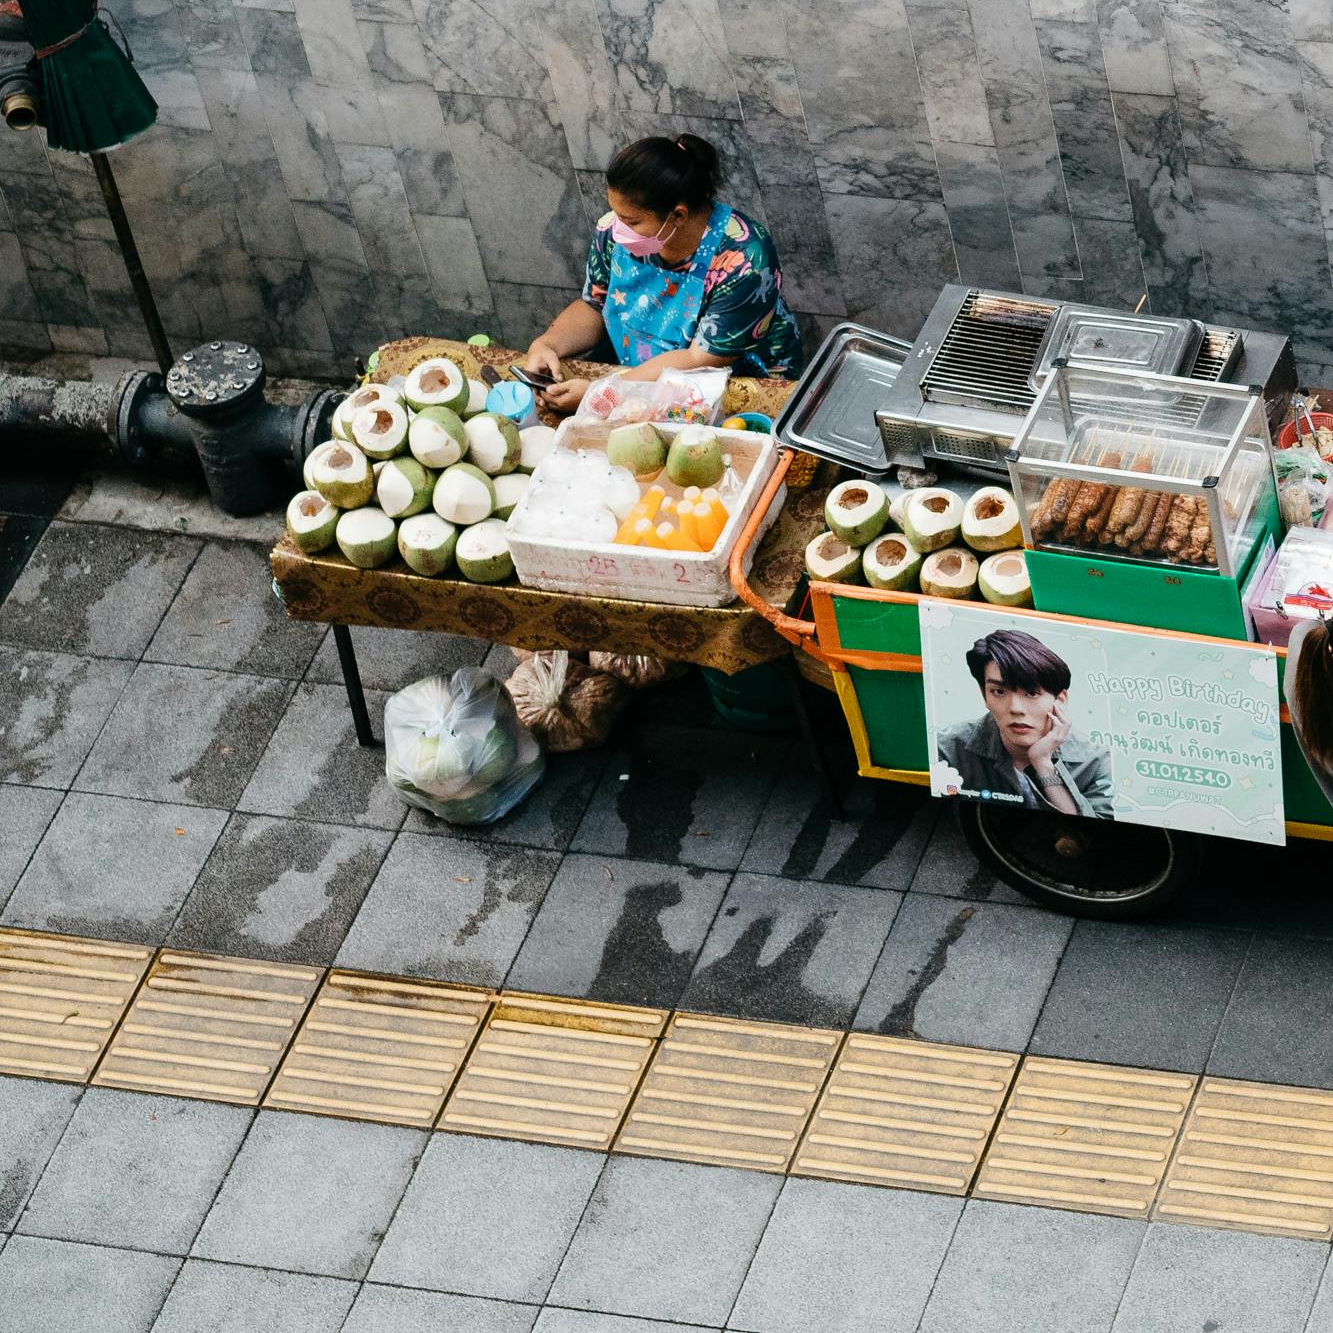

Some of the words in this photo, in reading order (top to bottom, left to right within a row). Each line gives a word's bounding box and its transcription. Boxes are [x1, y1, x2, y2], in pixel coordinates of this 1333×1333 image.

[1088, 672, 1162, 702] Happy
[1167, 675, 1270, 724] Birthday
[1137, 710, 1222, 735] คอปเตอร์
[1090, 729, 1174, 755] ภานุวัฒน์
[1179, 739, 1275, 771] เกิดทองทวี
[1138, 762, 1228, 786] 31.01.2540
[1148, 787, 1223, 804] #CTRPANUWAT
